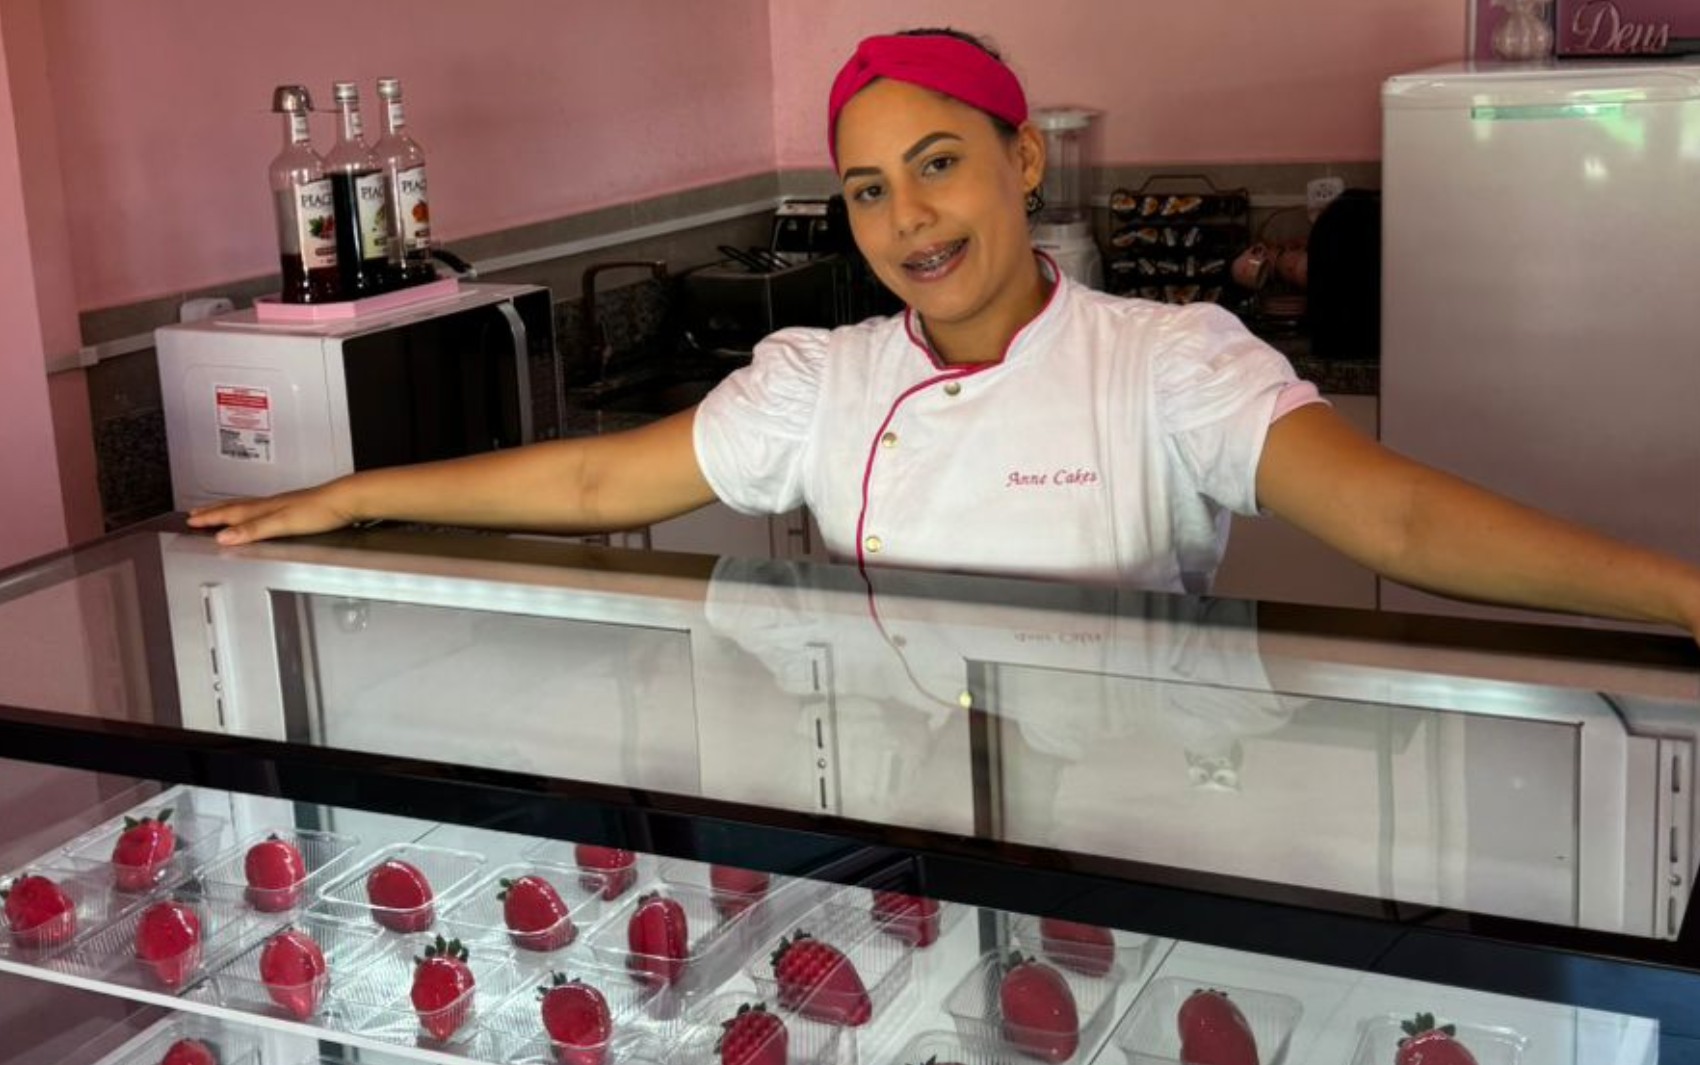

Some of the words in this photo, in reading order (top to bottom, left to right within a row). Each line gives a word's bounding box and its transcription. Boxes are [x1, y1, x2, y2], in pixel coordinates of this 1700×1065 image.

[1571, 0, 1670, 52] Deus
[1005, 470, 1047, 487] Anne
[1052, 468, 1098, 486] Cakes
